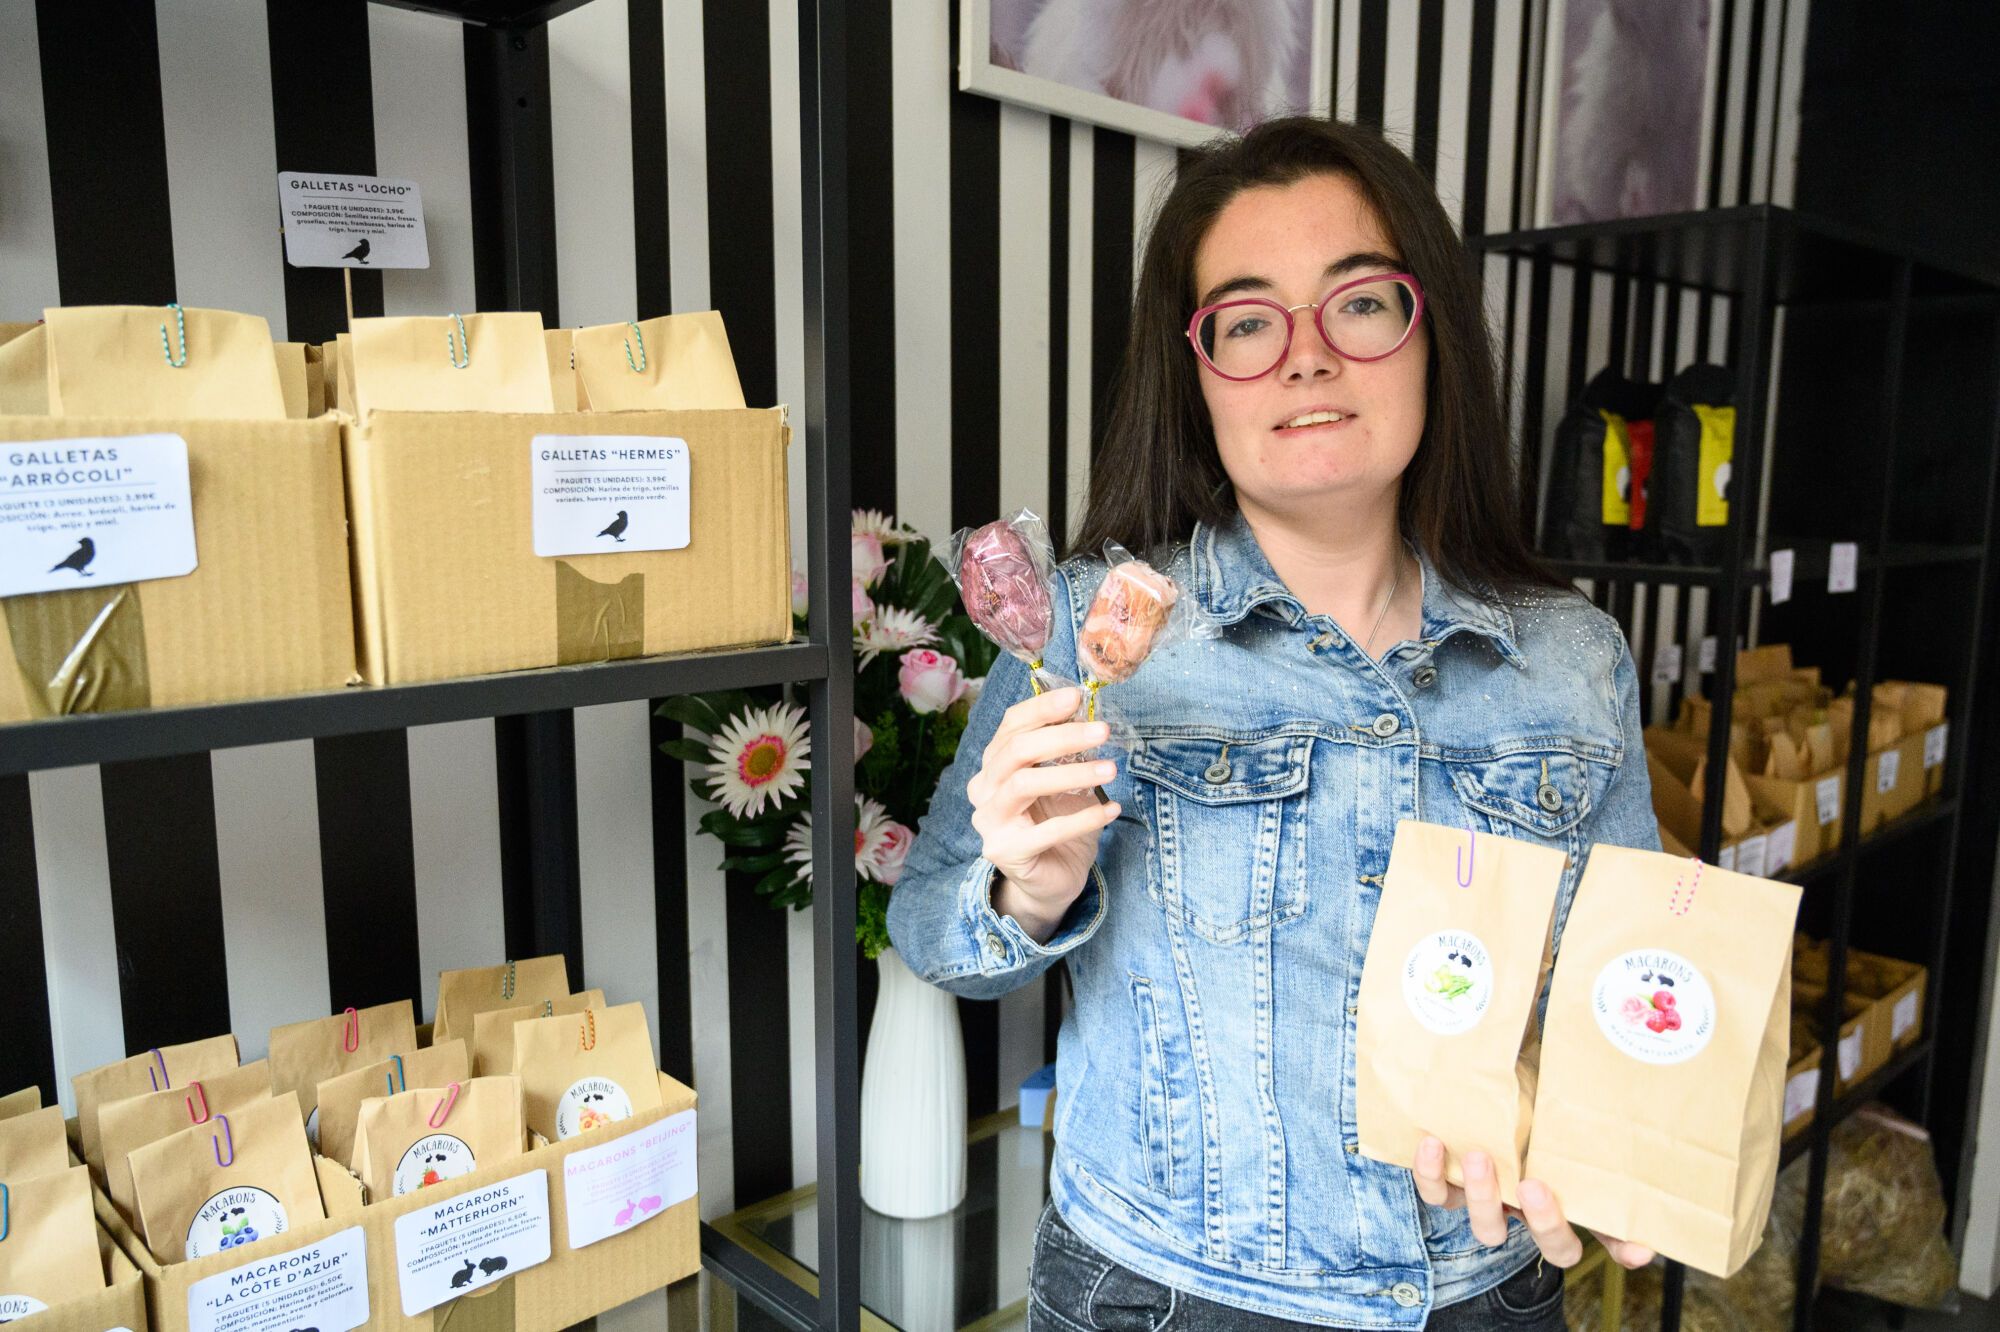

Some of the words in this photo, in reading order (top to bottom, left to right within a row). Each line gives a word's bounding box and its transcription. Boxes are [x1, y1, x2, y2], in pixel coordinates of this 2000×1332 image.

[290, 180, 354, 192] GALLETAS
[9, 448, 119, 467] GALLETAS
[541, 450, 606, 461] GALLETAS
[560, 477, 592, 485] PAQUETE
[1625, 955, 1694, 983] MACARONS
[570, 1081, 615, 1099] MACARONS
[413, 1140, 459, 1159] MACARONS
[567, 1145, 637, 1177] MACARONS
[201, 1192, 256, 1222] MACARONS
[434, 1186, 510, 1220] MACARONS
[425, 1236, 457, 1253] PAQUETE
[231, 1250, 321, 1286] MACARONS
[239, 1276, 281, 1298] CÔTE
[279, 1298, 304, 1310] Harina
[290, 1303, 312, 1314] avena
[319, 1286, 354, 1303] colorante
[221, 1303, 260, 1321] PAQUETE
